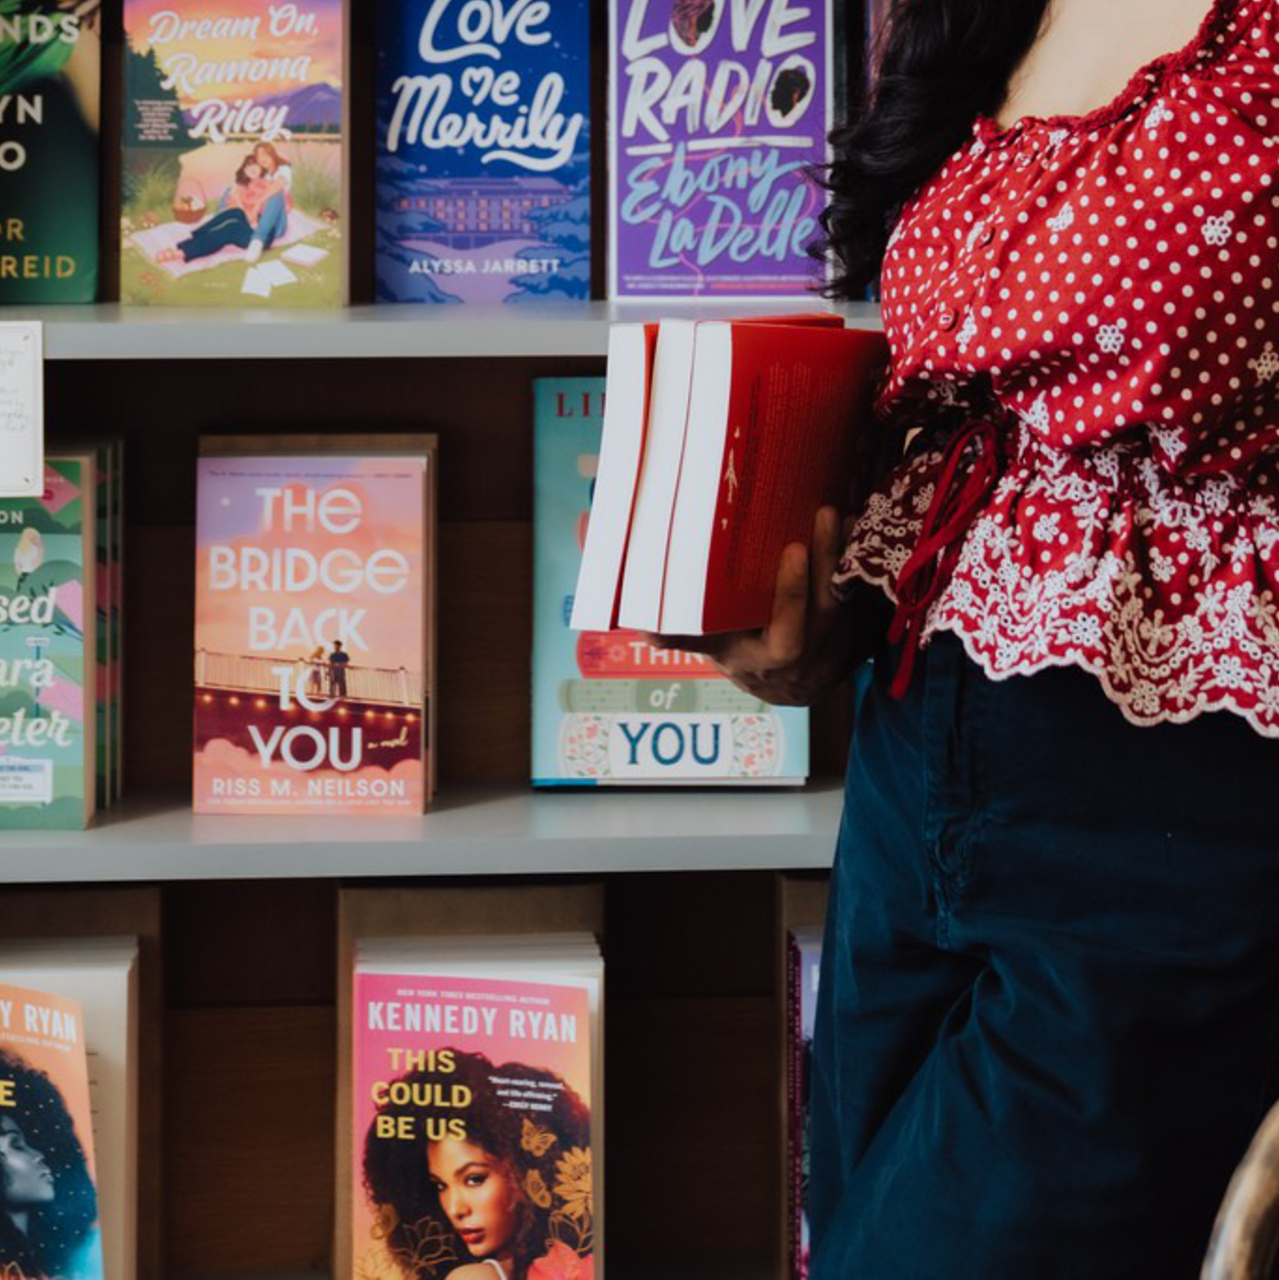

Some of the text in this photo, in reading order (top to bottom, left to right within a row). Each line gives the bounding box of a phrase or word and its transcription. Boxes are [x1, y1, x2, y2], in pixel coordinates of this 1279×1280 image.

[147, 9, 259, 45] Dream
[160, 51, 310, 95] Ramona
[622, 54, 817, 143] RADIO
[188, 97, 293, 144] Riley
[386, 71, 585, 172] Merrily
[621, 141, 815, 225] Ebony
[0, 254, 77, 278] REID
[408, 258, 561, 275] ALYSSA JARRETT
[247, 605, 369, 652] BACK
[648, 682, 681, 710] of
[247, 724, 362, 771] YOU
[619, 721, 722, 766] YOU
[211, 777, 406, 797] RISS M. NEILSON
[23, 1002, 78, 1044] RYAN
[367, 1001, 578, 1044] KENNEDY RYAN
[386, 1048, 457, 1074] THIS
[370, 1081, 472, 1108] COULD
[375, 1116, 468, 1142] BE US
